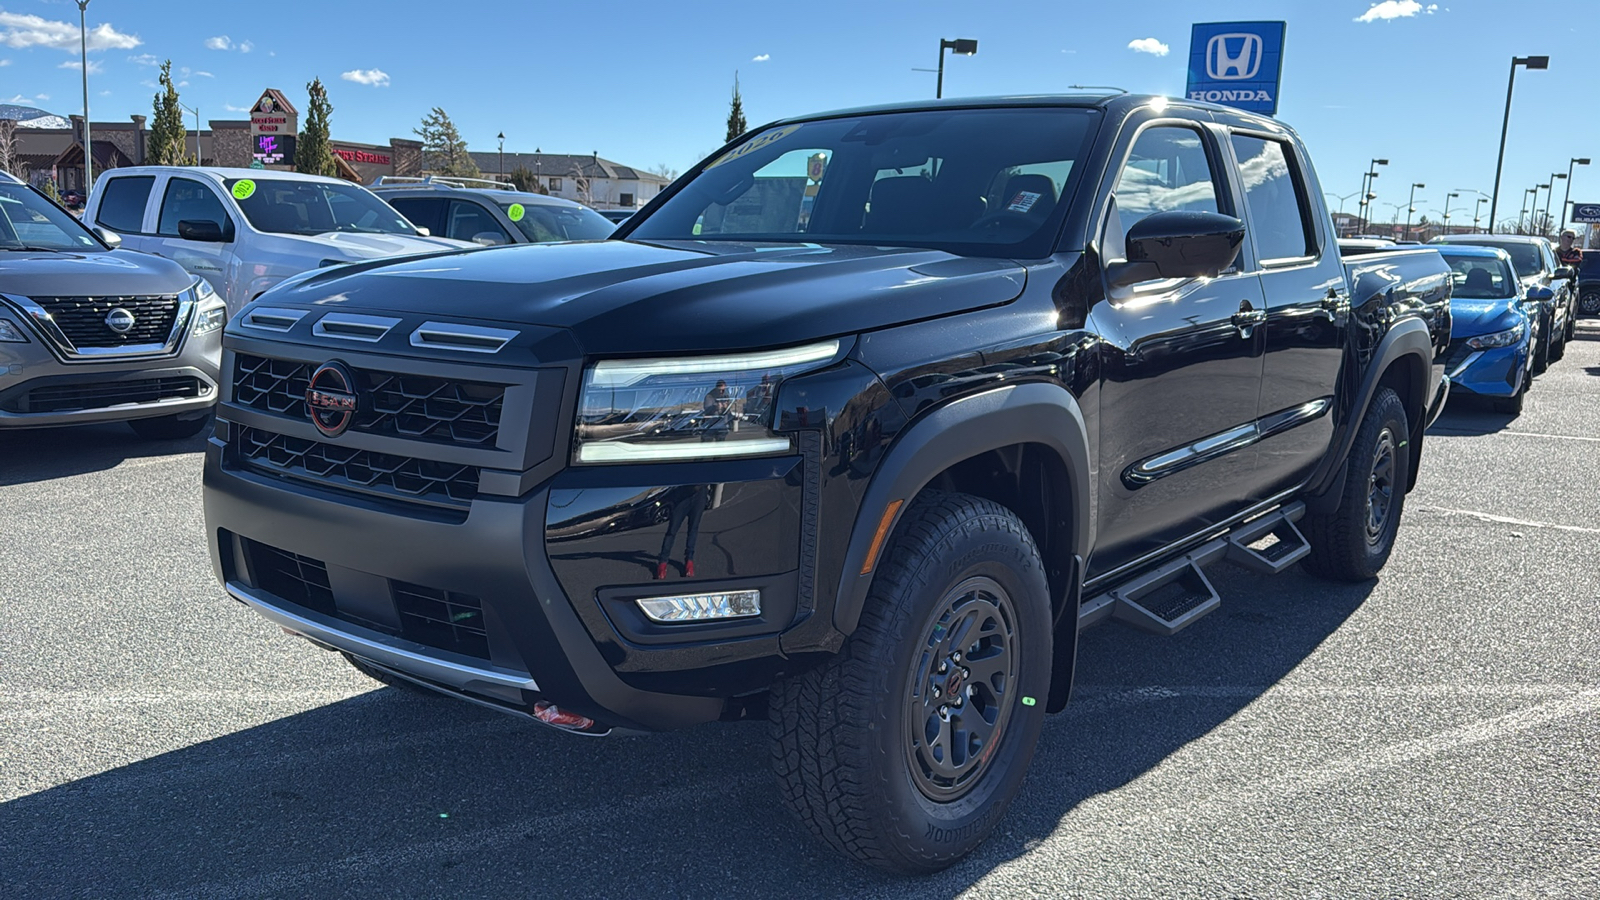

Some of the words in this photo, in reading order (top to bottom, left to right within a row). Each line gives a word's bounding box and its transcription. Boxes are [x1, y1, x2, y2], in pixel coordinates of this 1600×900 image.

[1189, 90, 1272, 102] HONDA
[722, 131, 784, 163] 2026
[356, 150, 391, 165] STRIKE
